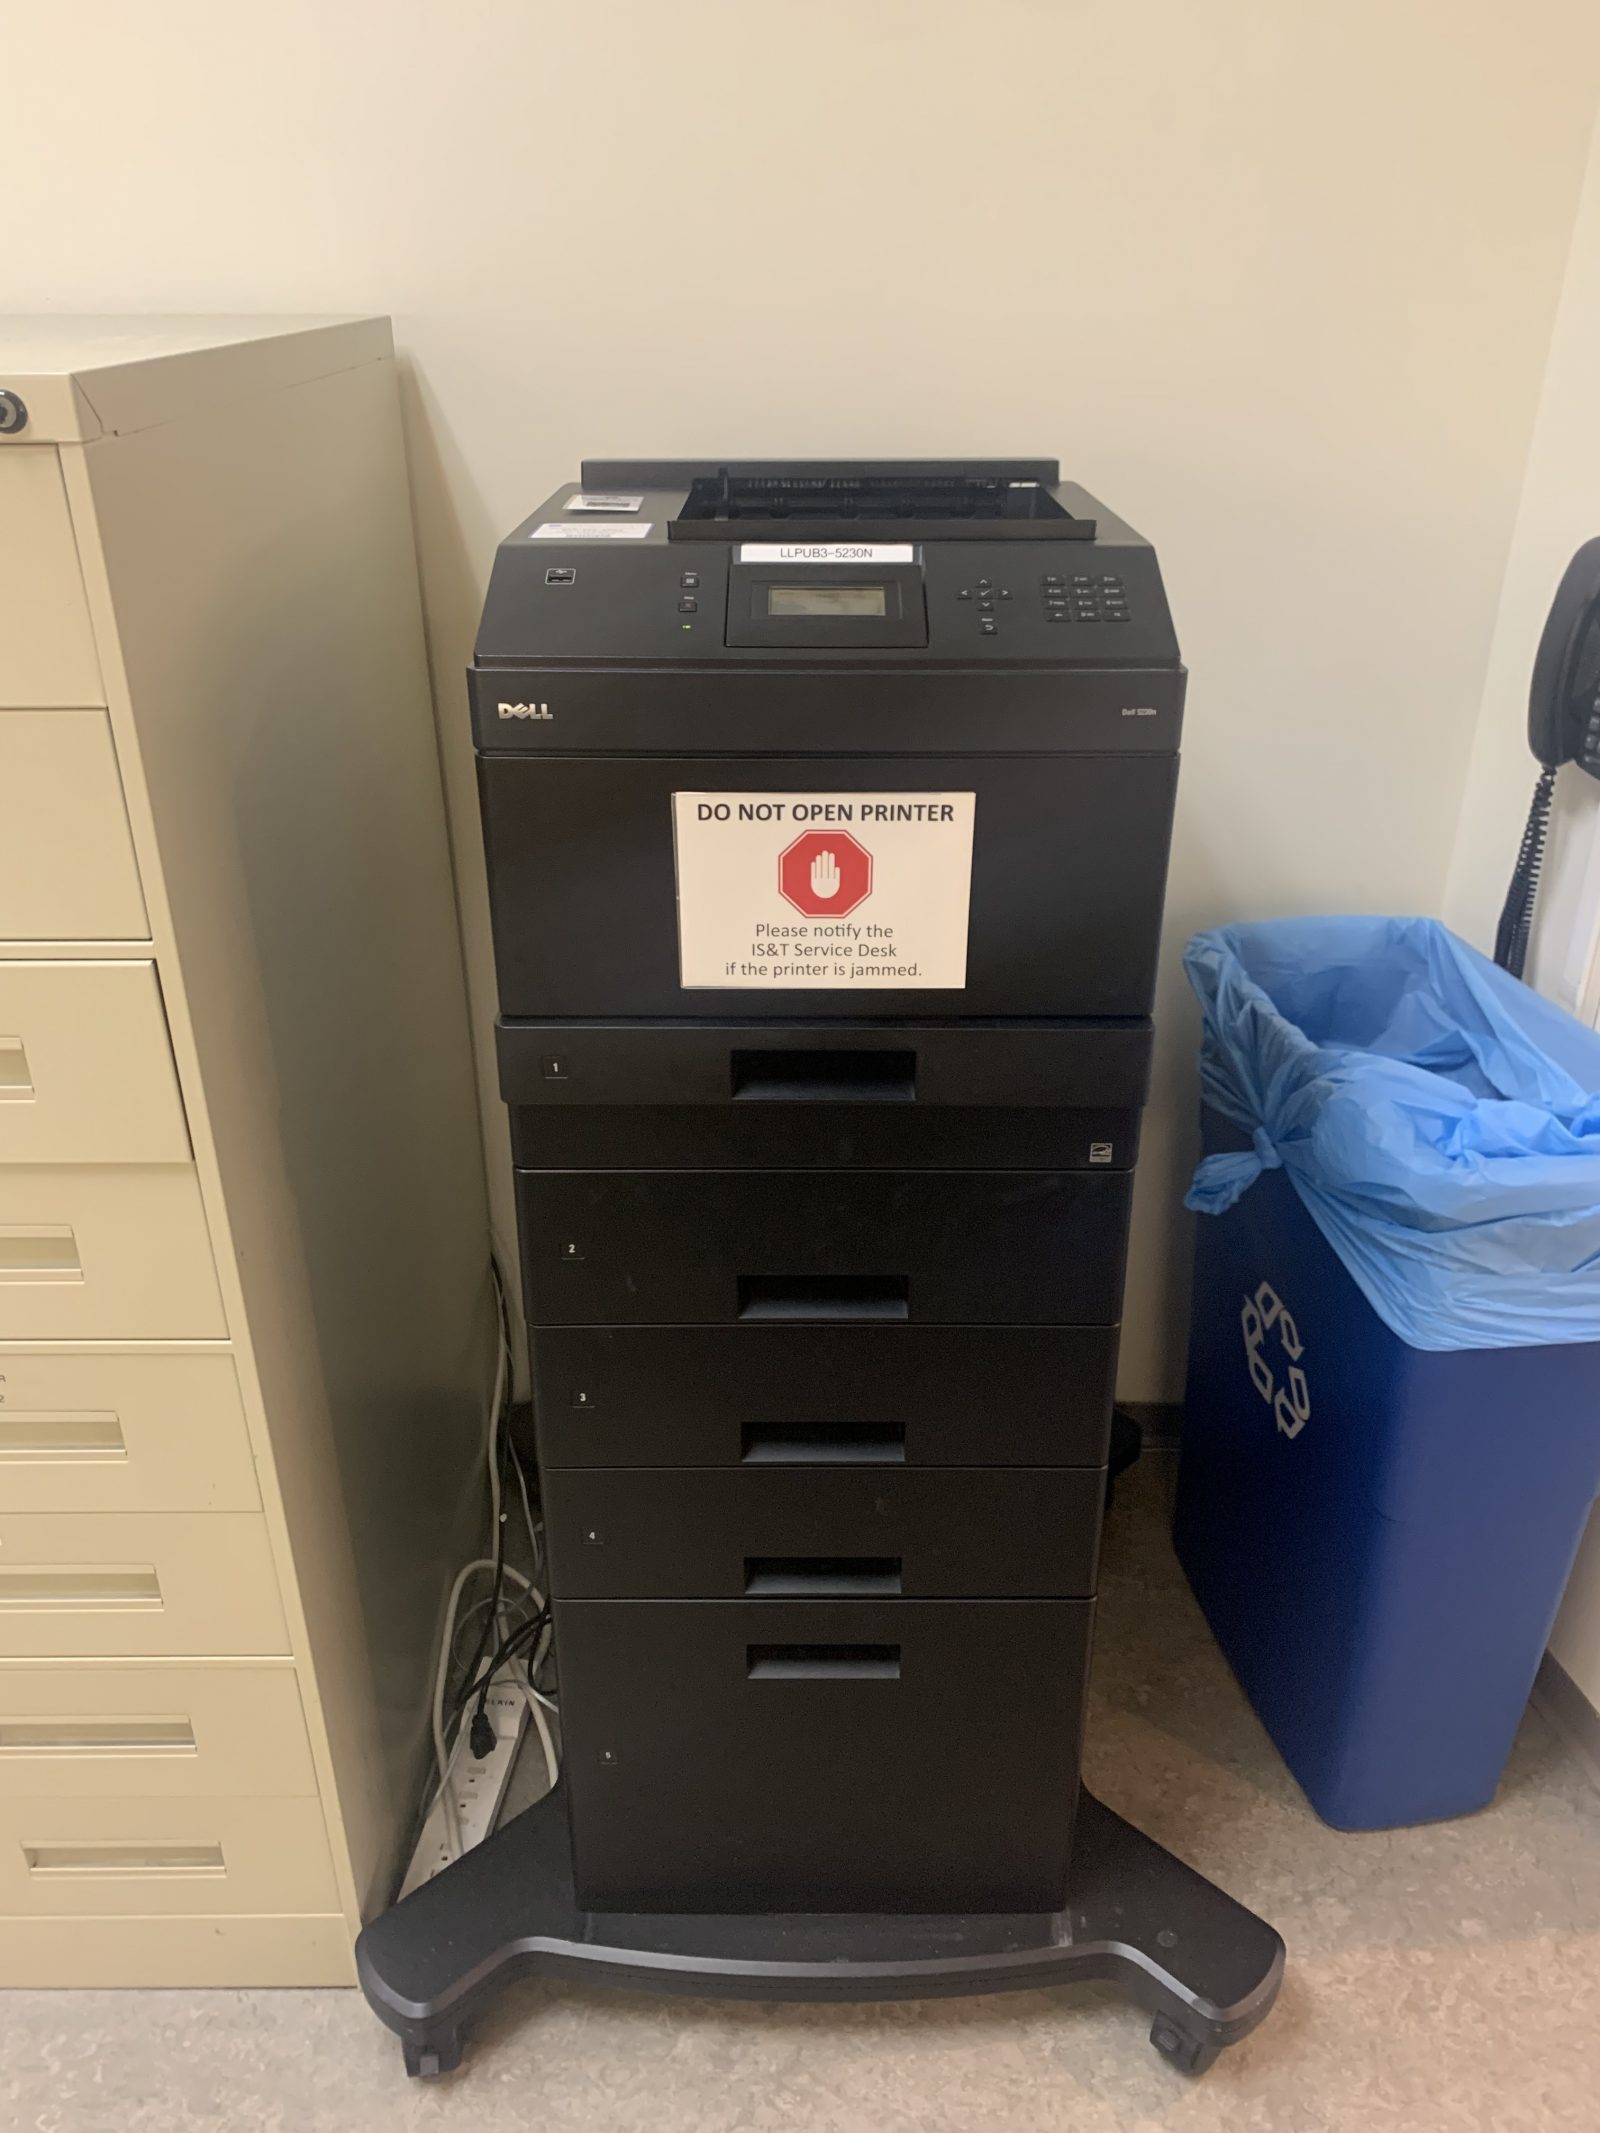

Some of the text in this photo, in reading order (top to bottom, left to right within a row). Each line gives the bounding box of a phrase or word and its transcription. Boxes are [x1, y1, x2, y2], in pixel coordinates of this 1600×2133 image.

[780, 547, 873, 559] LLPUB3-5230N
[497, 702, 554, 719] DELL
[697, 803, 954, 822] DO NOT OPEN PRINTER
[756, 923, 894, 941] Please notify the
[751, 942, 897, 958] IS&T Service Desk
[725, 961, 923, 979] if the printer is jammed.
[552, 1062, 559, 1073] 1
[567, 1242, 577, 1255] 2
[578, 1391, 588, 1403] 3
[588, 1530, 597, 1540] 4
